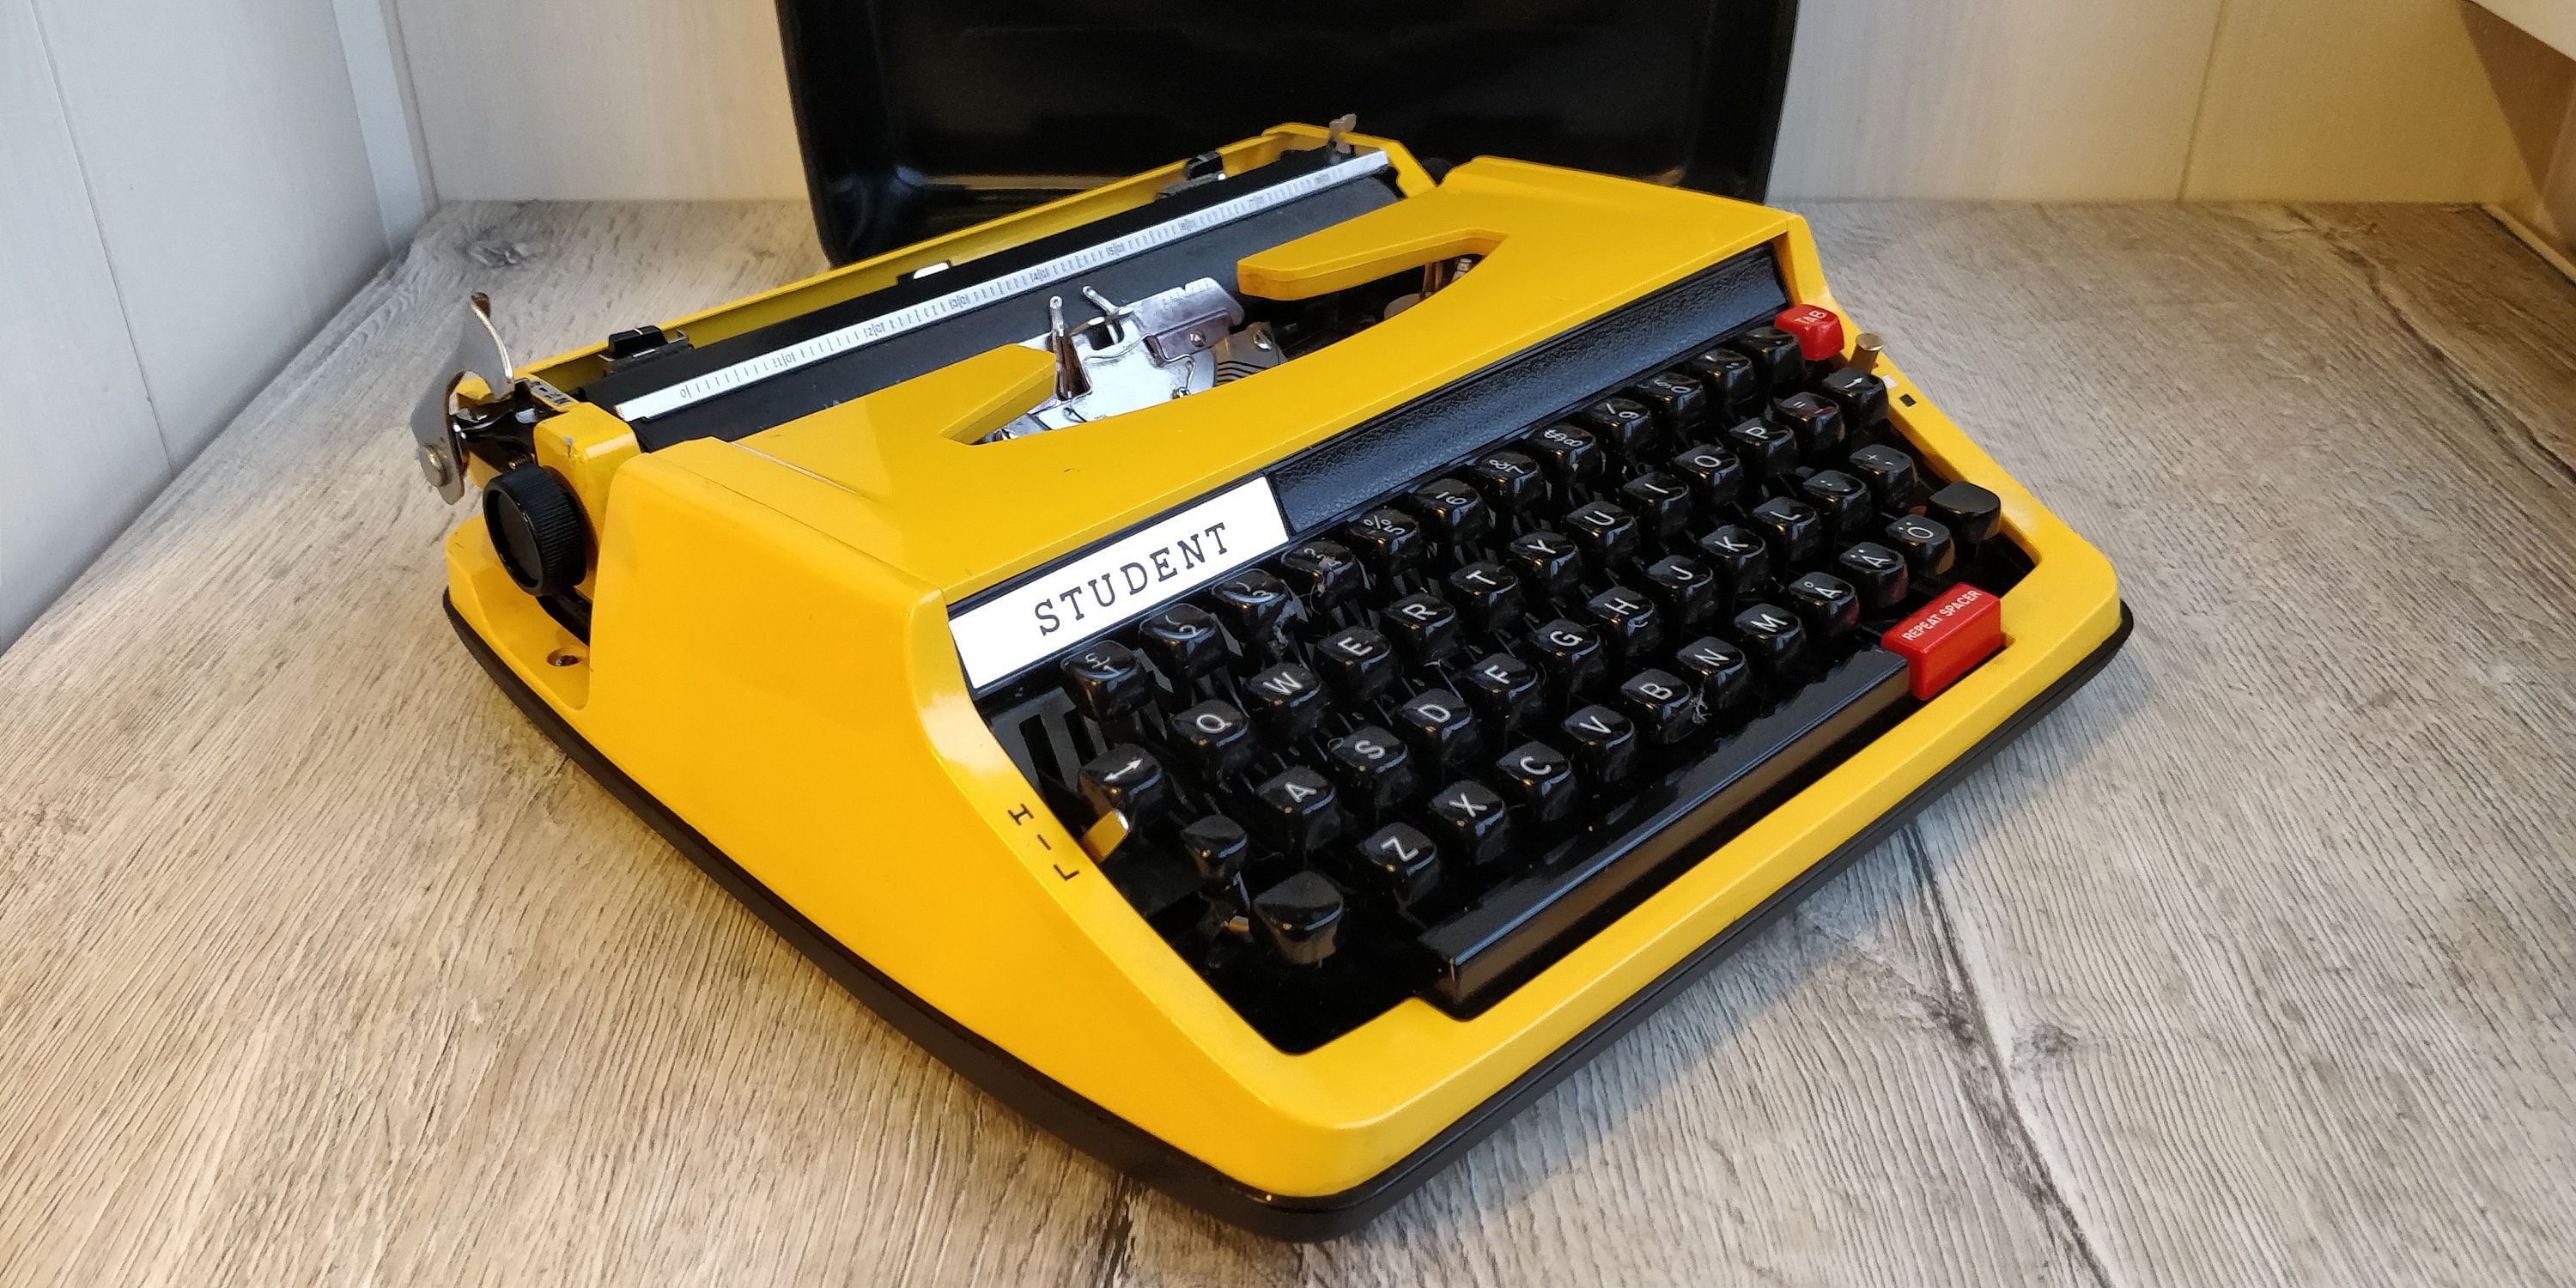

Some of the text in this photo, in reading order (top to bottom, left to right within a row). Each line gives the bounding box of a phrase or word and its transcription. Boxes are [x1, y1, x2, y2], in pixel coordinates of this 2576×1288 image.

[1794, 310, 1827, 325] TAB
[1034, 522, 1228, 636] STUDENT
[1196, 427, 1769, 733] Q W E R T Y U I O P
[1285, 511, 1801, 803] A S D F G H J K L
[1902, 590, 1983, 642] REPEAT SPACER
[1381, 835, 1419, 862] Z
[1449, 793, 1488, 817] X
[1520, 756, 1552, 775] C
[1578, 715, 1612, 733] V
[1639, 683, 1674, 700] B
[1694, 648, 1729, 666] N
[1750, 613, 1789, 633] M
